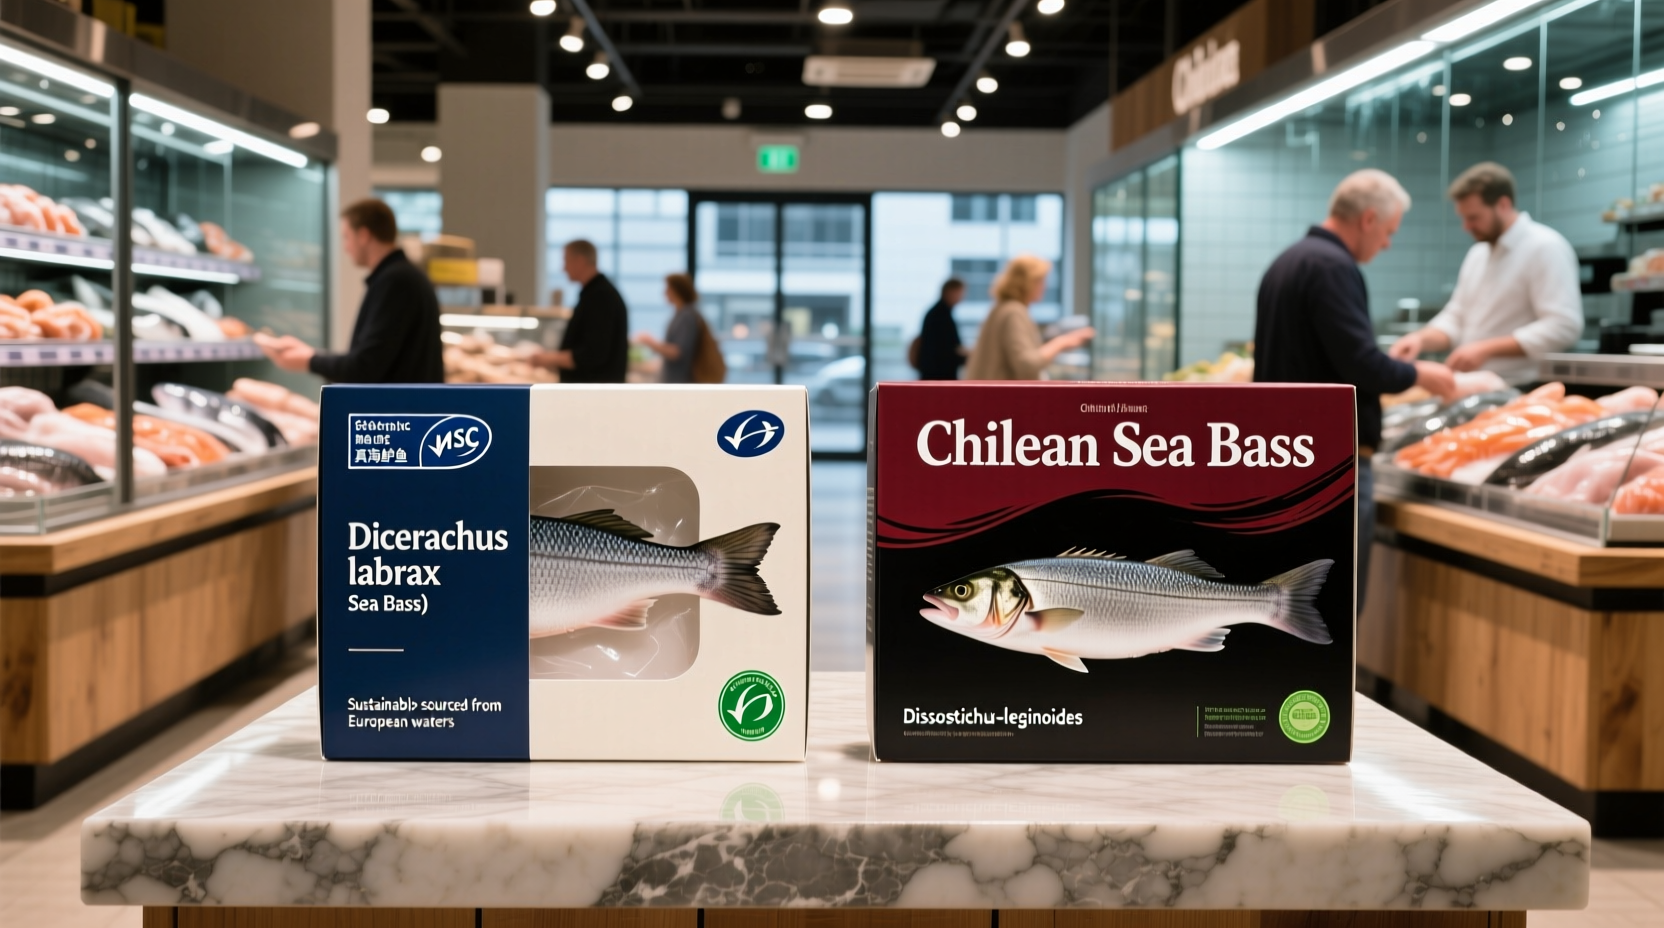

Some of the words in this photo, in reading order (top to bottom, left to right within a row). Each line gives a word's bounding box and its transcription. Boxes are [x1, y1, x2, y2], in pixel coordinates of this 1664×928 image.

[917, 418, 1101, 467] Chilean
[1113, 421, 1196, 467] Sea
[1207, 422, 1315, 468] Bass
[348, 519, 509, 551] Dicerachus
[348, 555, 441, 586] labrax
[348, 594, 379, 612] Sea
[383, 593, 428, 616] Bass)
[421, 698, 468, 712] sourced
[472, 697, 502, 712] from
[348, 714, 409, 732] European
[411, 716, 455, 728] waters
